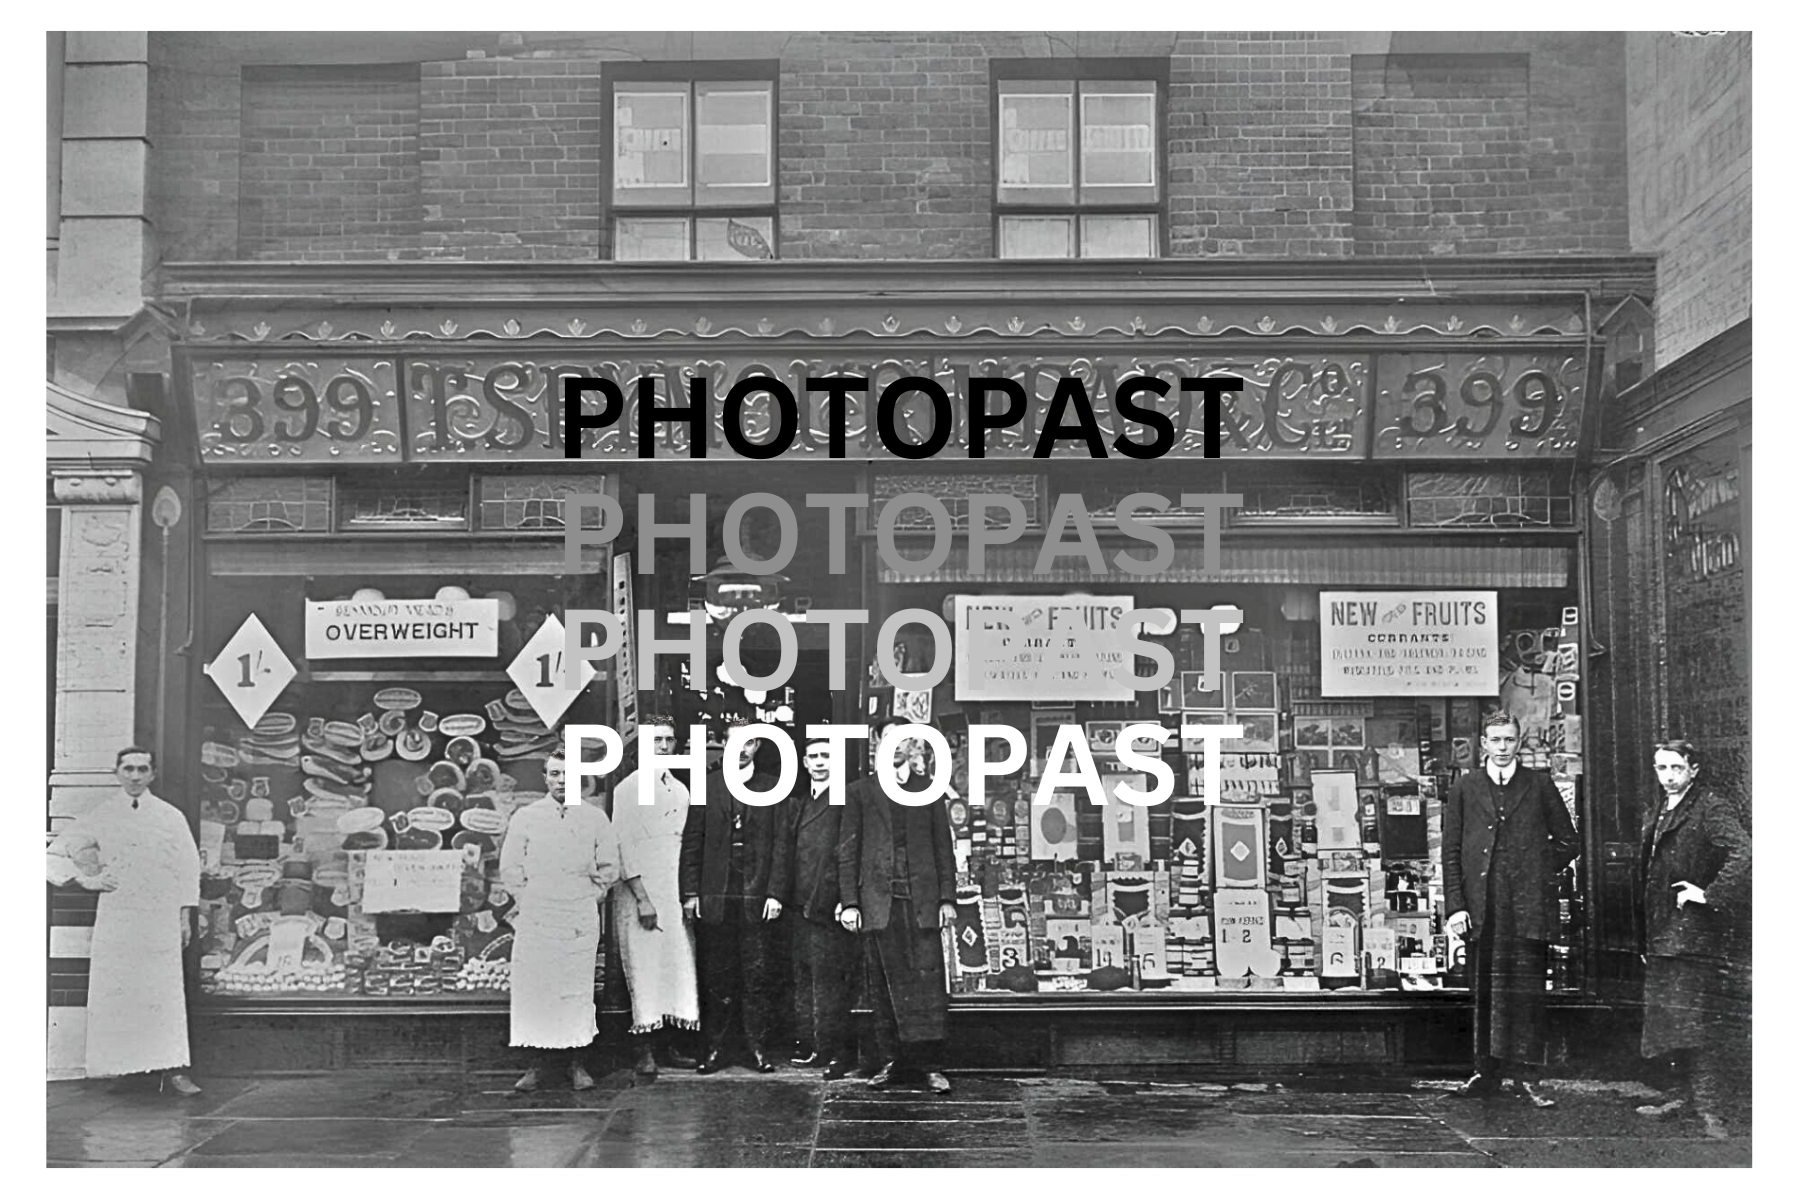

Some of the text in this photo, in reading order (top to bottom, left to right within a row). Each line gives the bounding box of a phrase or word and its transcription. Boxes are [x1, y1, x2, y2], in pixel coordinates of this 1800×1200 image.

[216, 374, 374, 443] 399
[1401, 371, 1554, 438] 399
[326, 622, 479, 640] OVERWEIGHT
[1331, 602, 1378, 626] NEW
[1412, 602, 1486, 626] FRUITS
